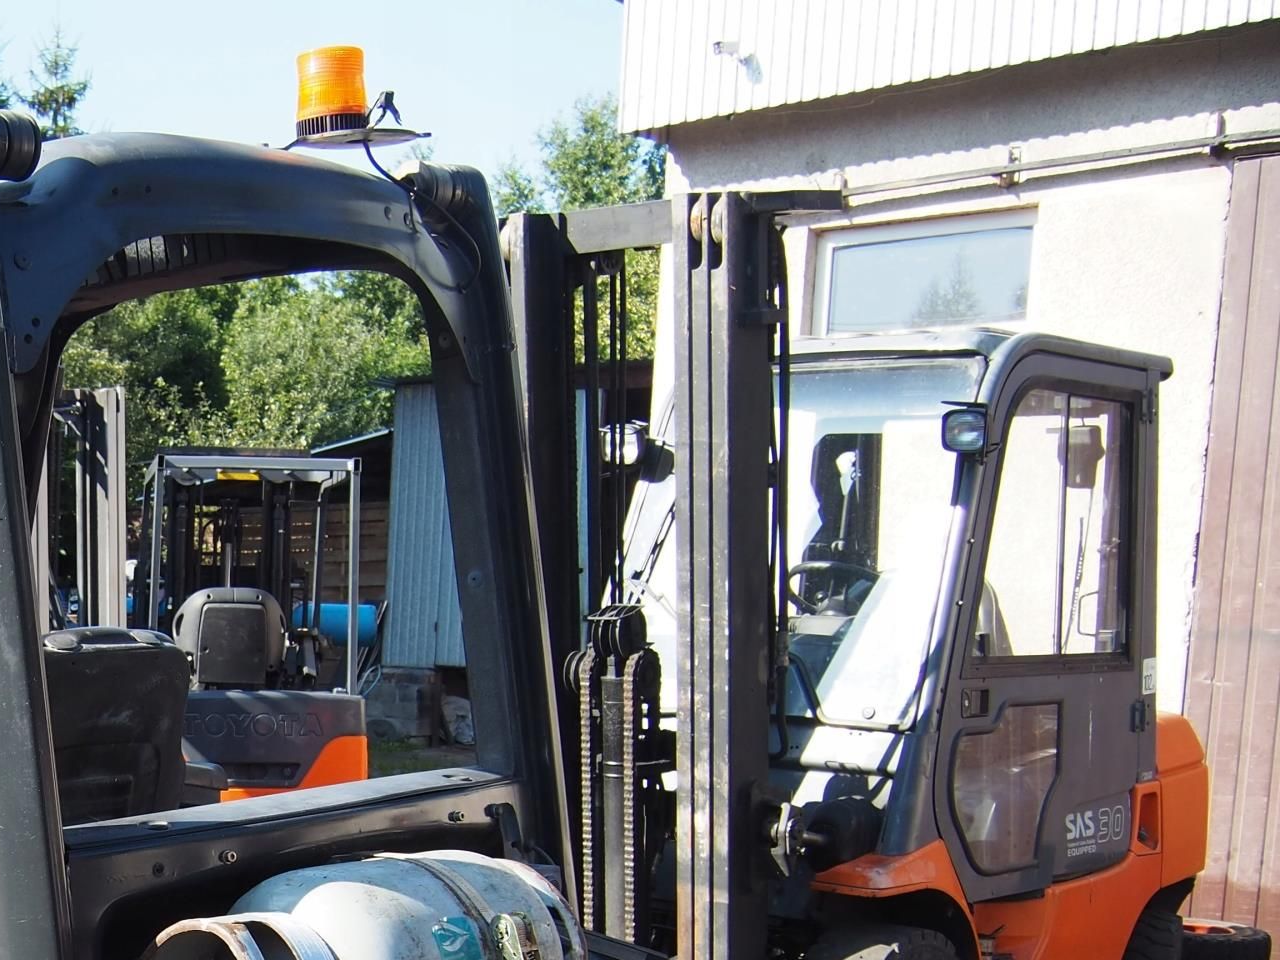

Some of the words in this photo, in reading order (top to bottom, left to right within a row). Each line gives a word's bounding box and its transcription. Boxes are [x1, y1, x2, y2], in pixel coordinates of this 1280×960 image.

[183, 712, 325, 738] TOYOTA
[1065, 810, 1096, 841] SAS
[1097, 805, 1125, 843] 30
[1067, 844, 1097, 857] EQUIPPED
